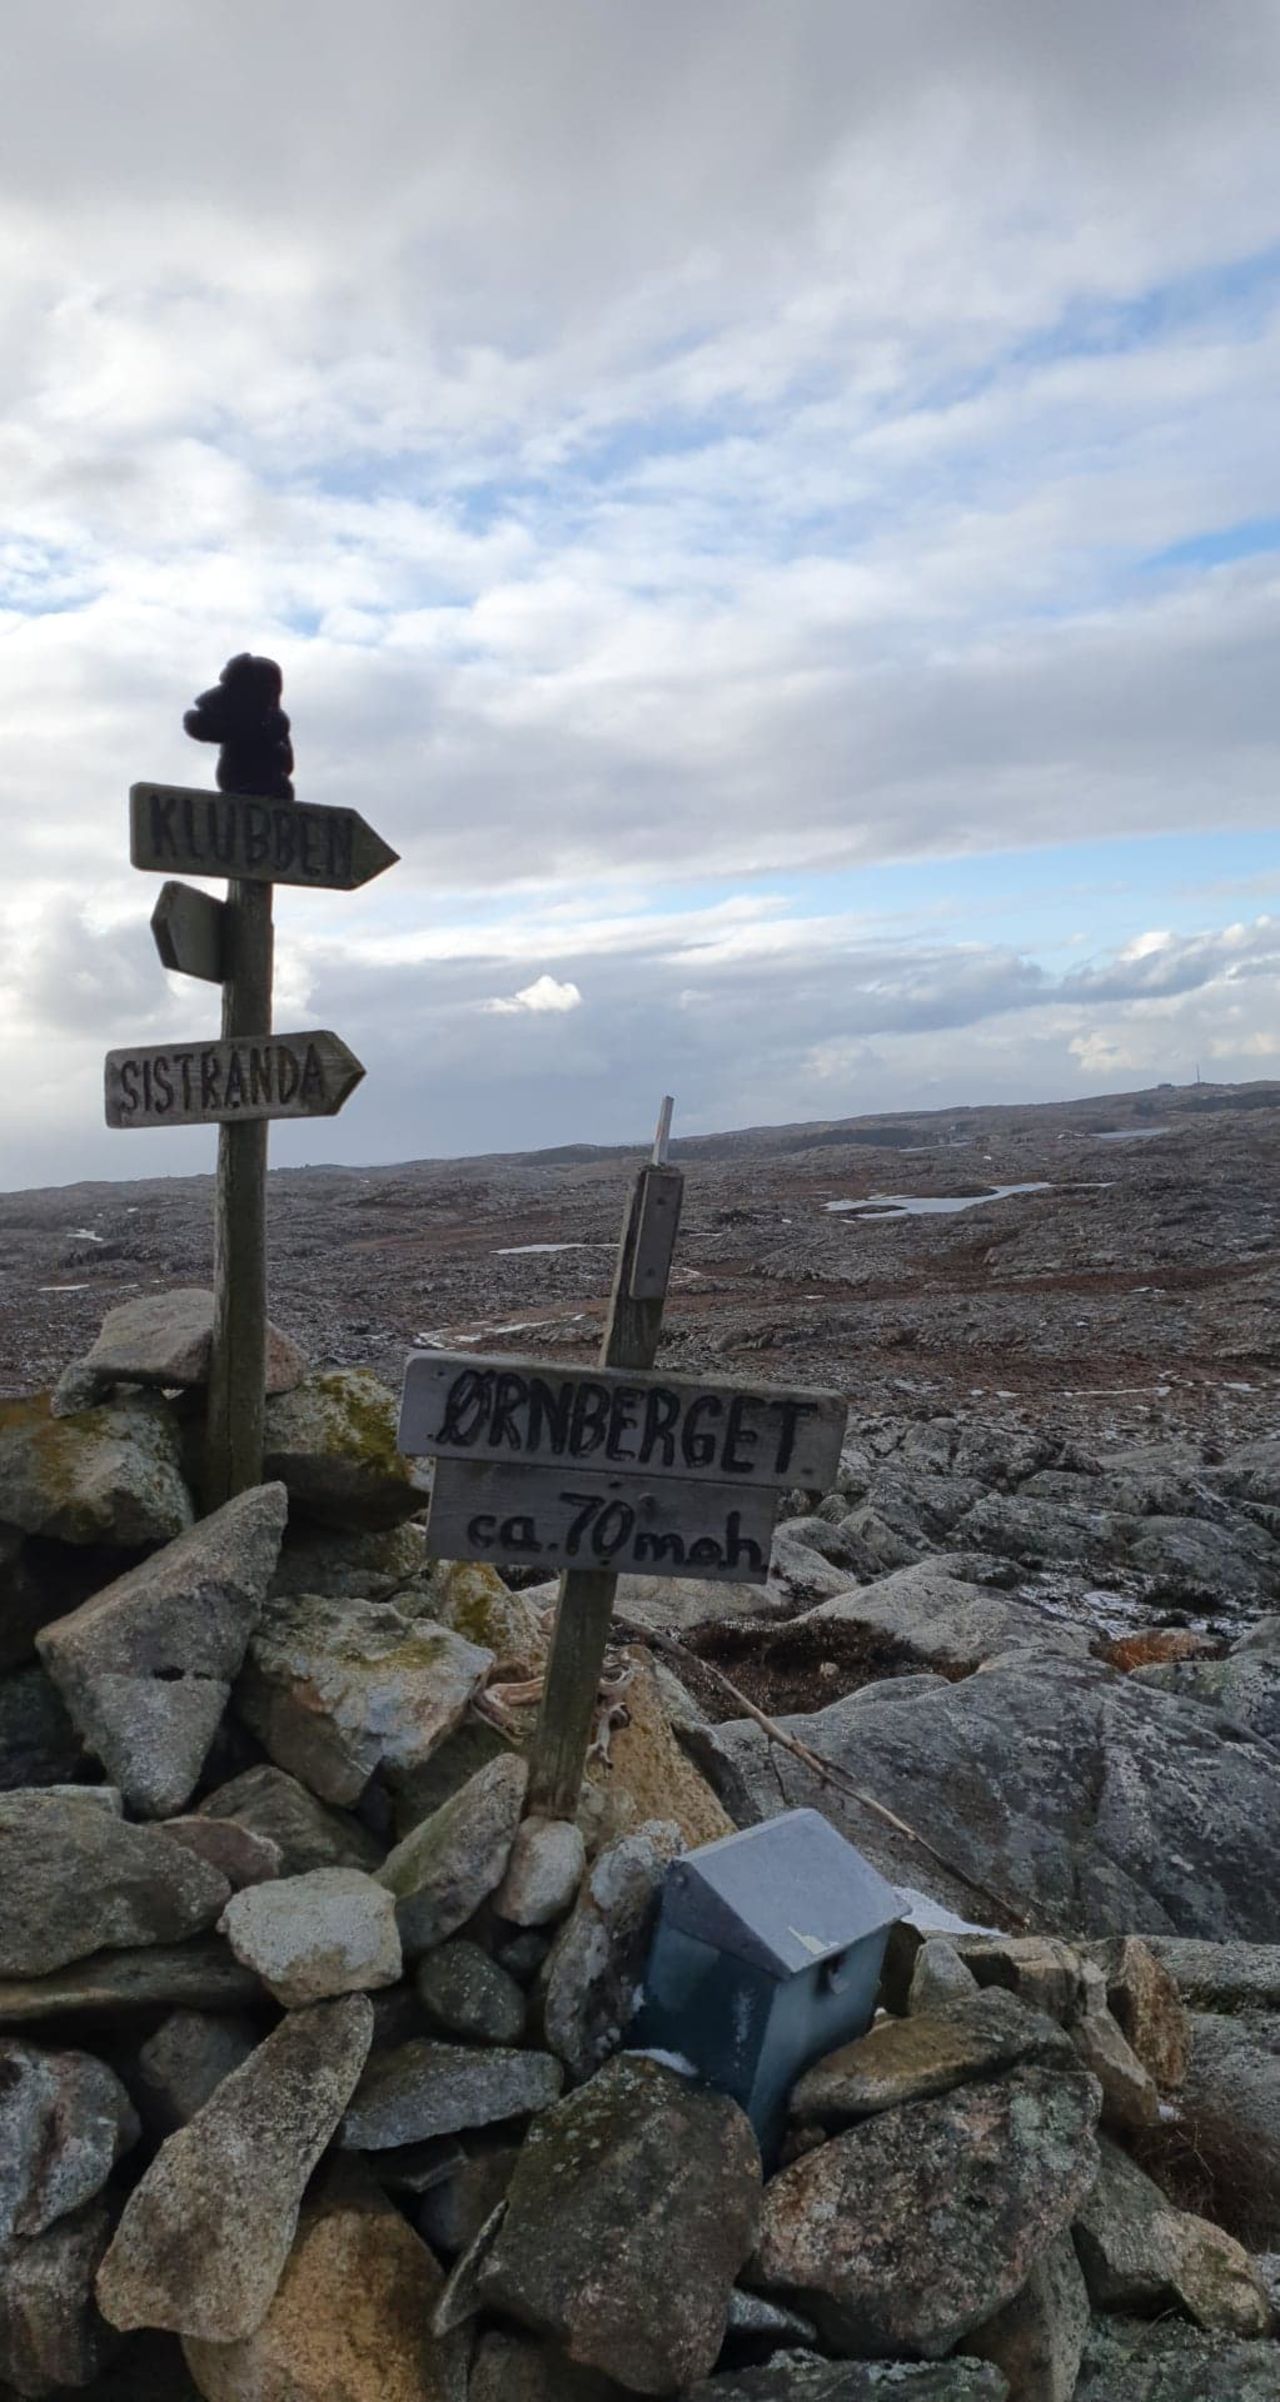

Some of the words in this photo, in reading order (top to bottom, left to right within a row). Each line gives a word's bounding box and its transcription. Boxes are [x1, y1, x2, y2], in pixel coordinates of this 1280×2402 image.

[148, 795, 354, 878] KLUBBEN
[118, 1042, 324, 1114] SISTRANDA
[434, 1368, 818, 1474] ØRNBERGET
